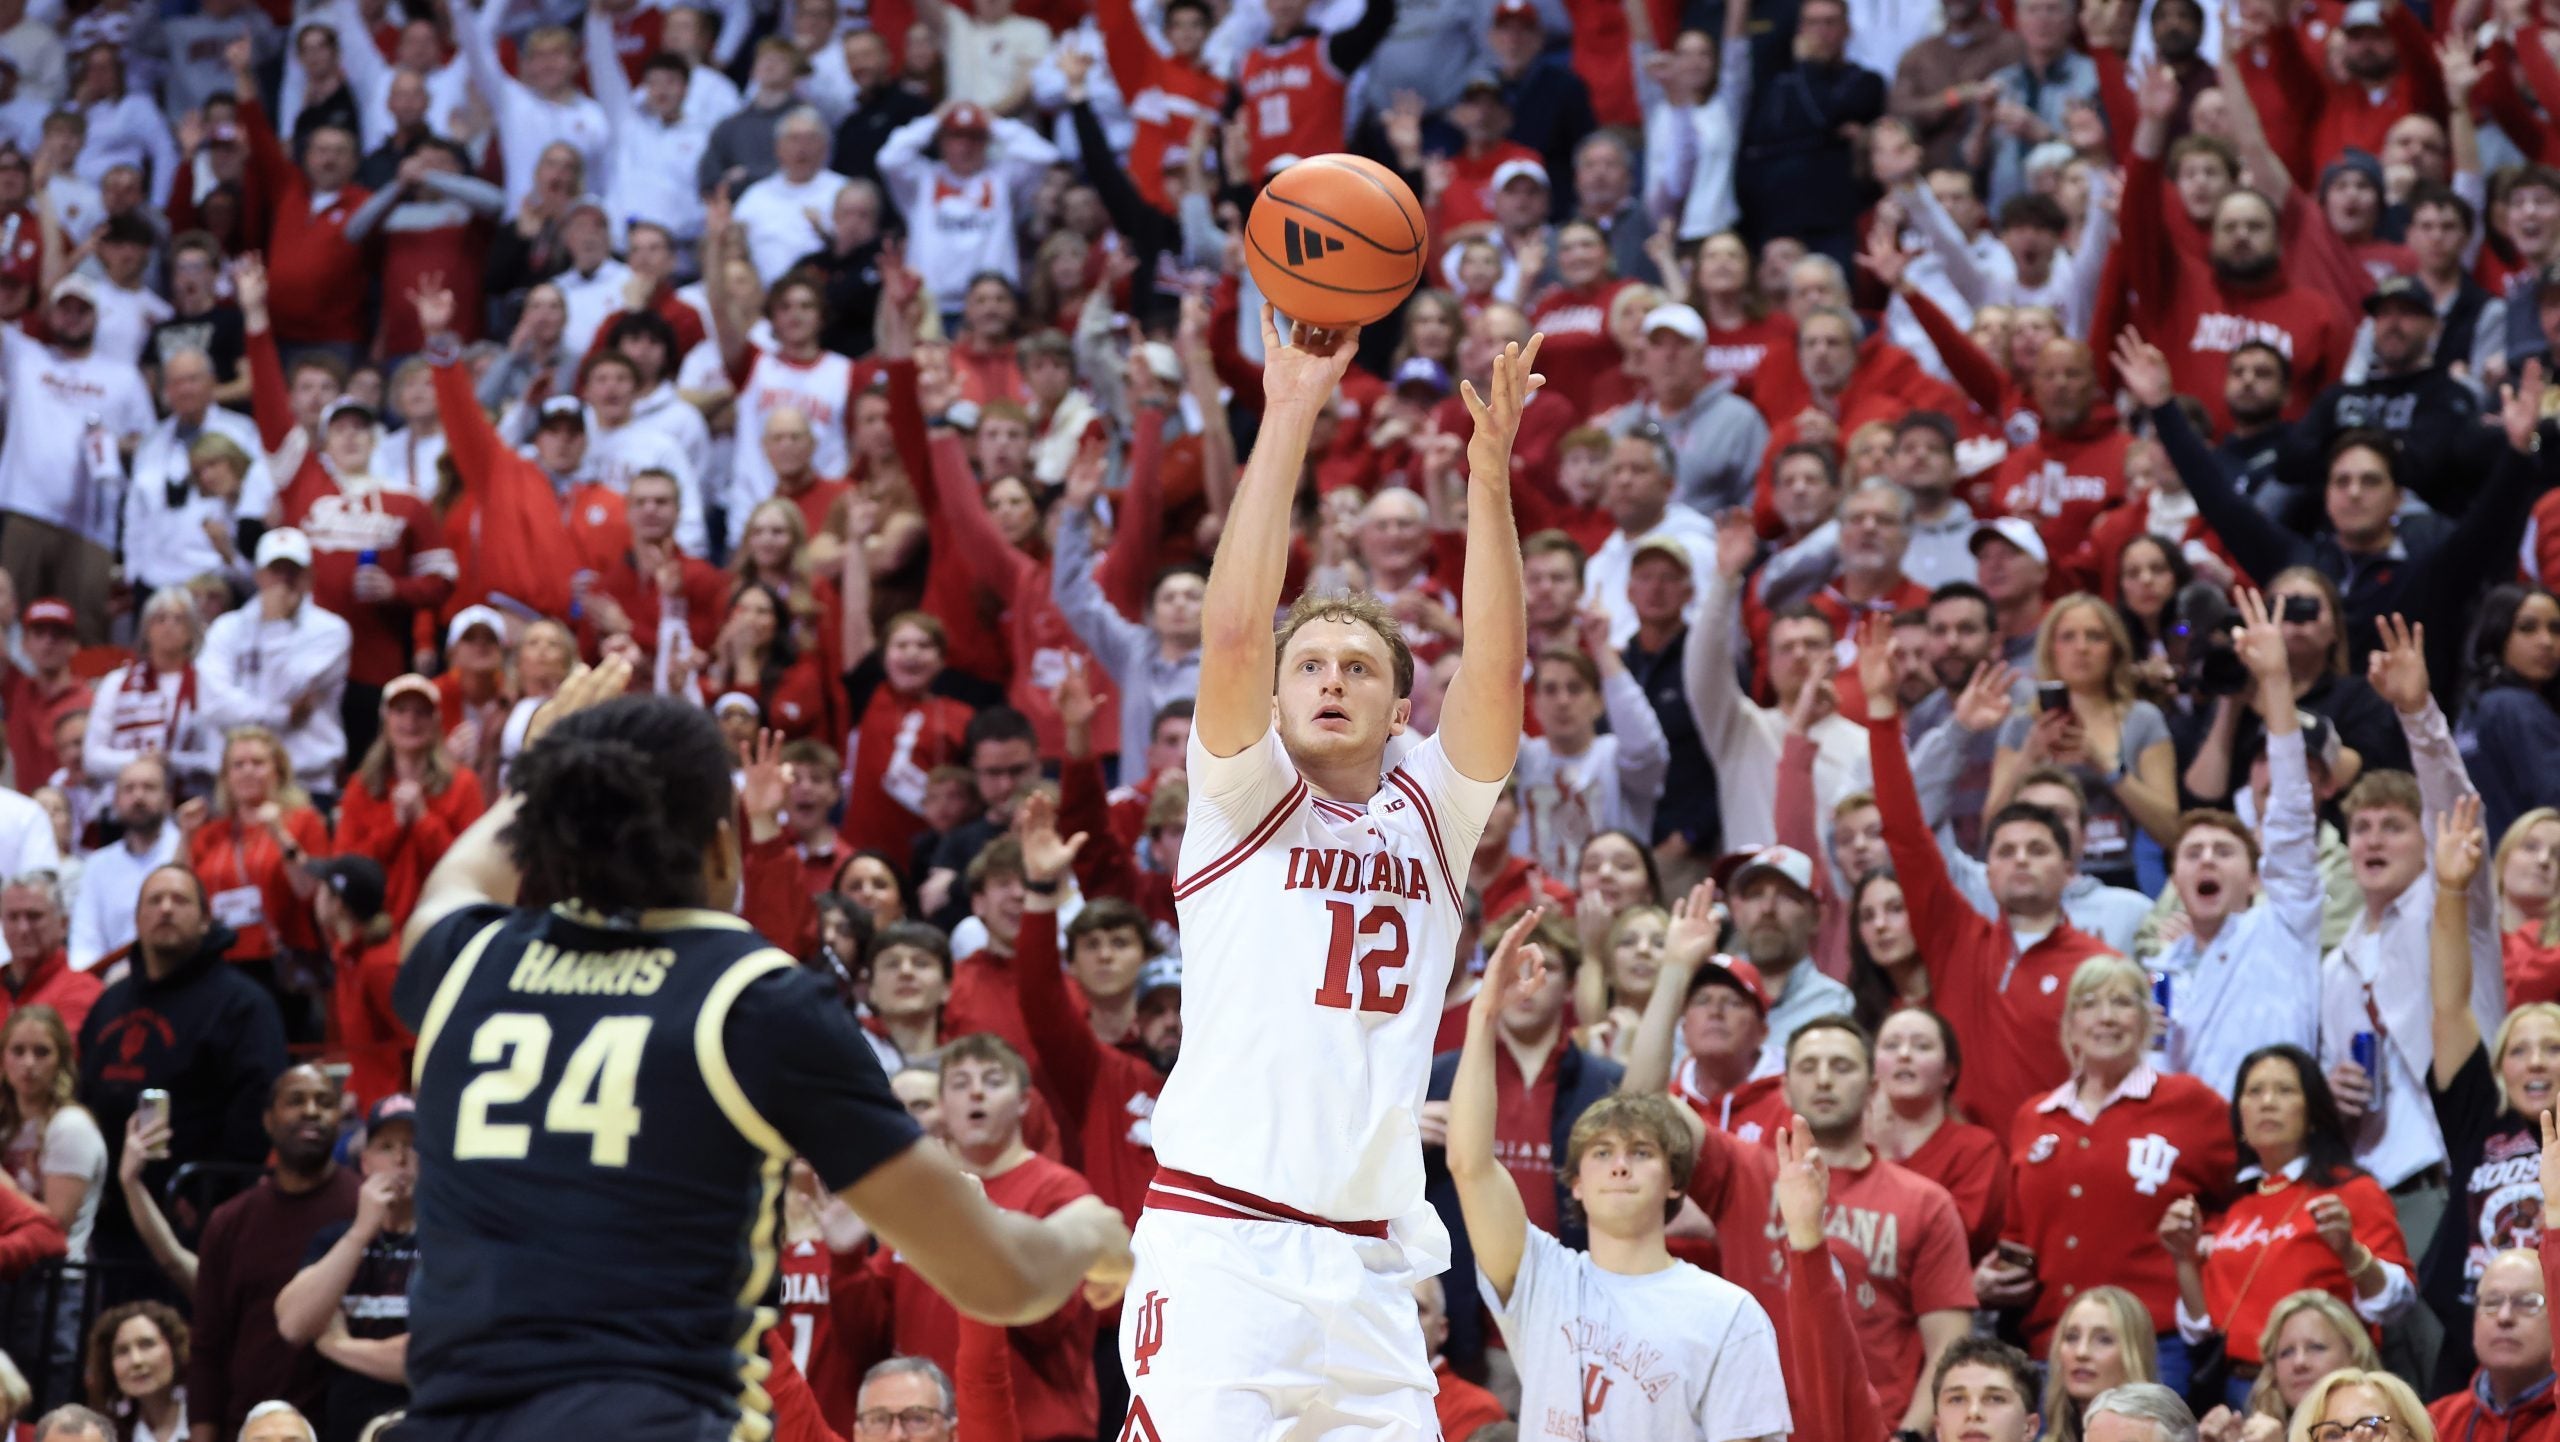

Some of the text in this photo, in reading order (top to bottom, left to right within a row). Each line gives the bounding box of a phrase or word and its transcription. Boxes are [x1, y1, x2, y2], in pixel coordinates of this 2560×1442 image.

[1284, 847, 1431, 904] INDIANA
[508, 939, 677, 997] HARRIS
[1315, 899, 1410, 1014] 12
[453, 1011, 655, 1168] 24
[1561, 1316, 1679, 1404] IDIANA
